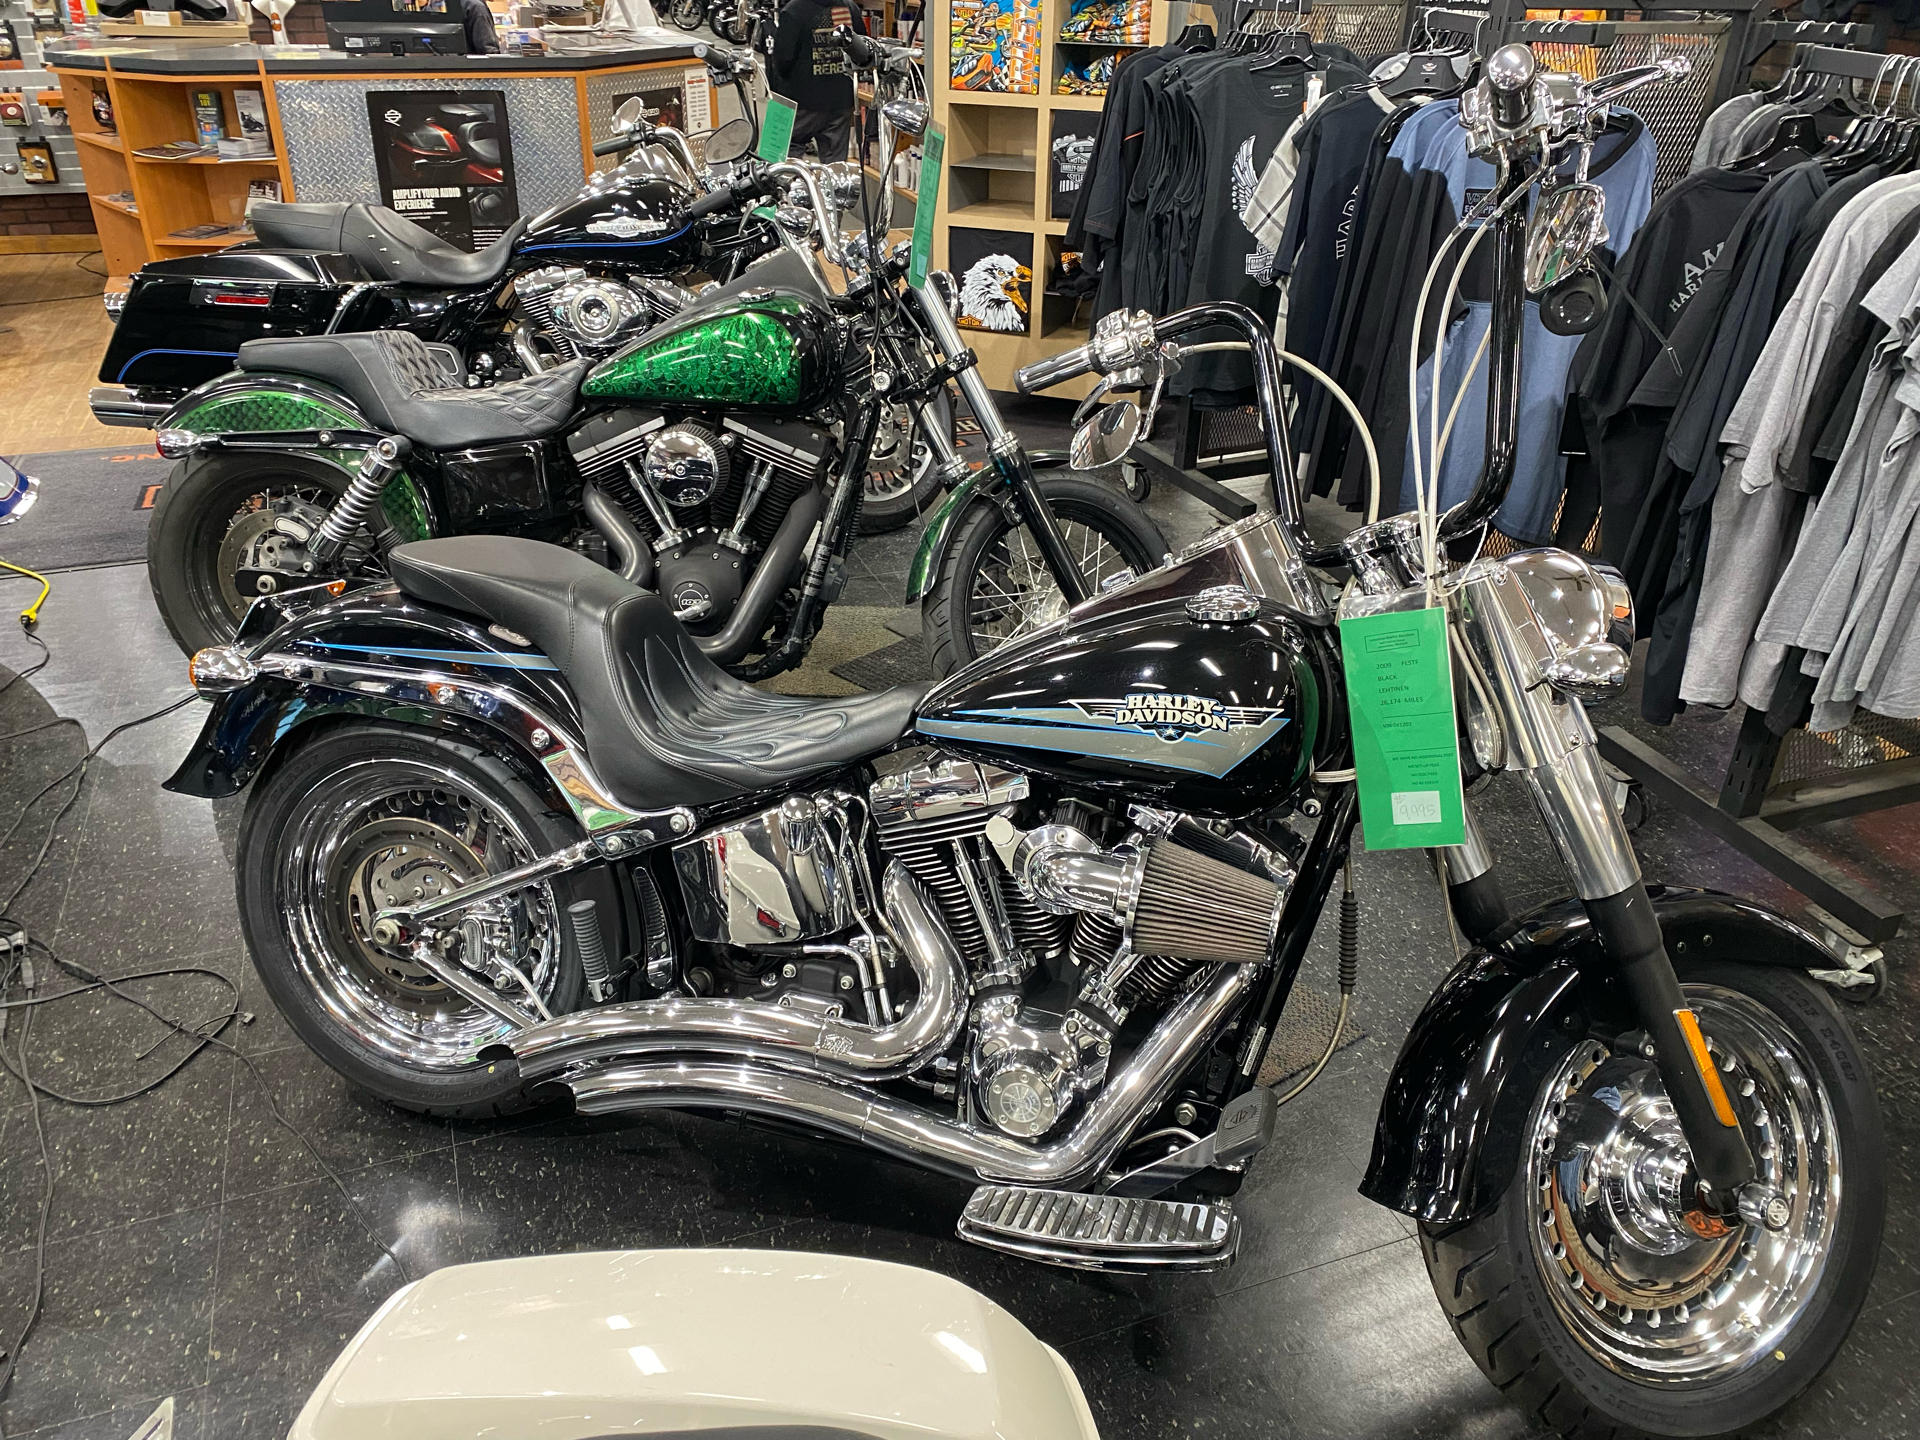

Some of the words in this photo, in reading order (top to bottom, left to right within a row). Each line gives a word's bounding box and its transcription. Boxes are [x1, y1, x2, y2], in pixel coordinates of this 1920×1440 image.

[392, 188, 421, 200] AMPLIFY
[421, 187, 440, 199] YOUR
[440, 186, 461, 198] AUDIO
[394, 199, 436, 211] EXPERIENCE
[1377, 674, 1398, 682] BLACK
[1378, 685, 1410, 694] LEHTINEN
[1126, 693, 1226, 714] HARLEY-
[1380, 698, 1401, 706] 26,174
[1115, 708, 1230, 732] DAVIDSON
[1399, 803, 1436, 821] 9,995
